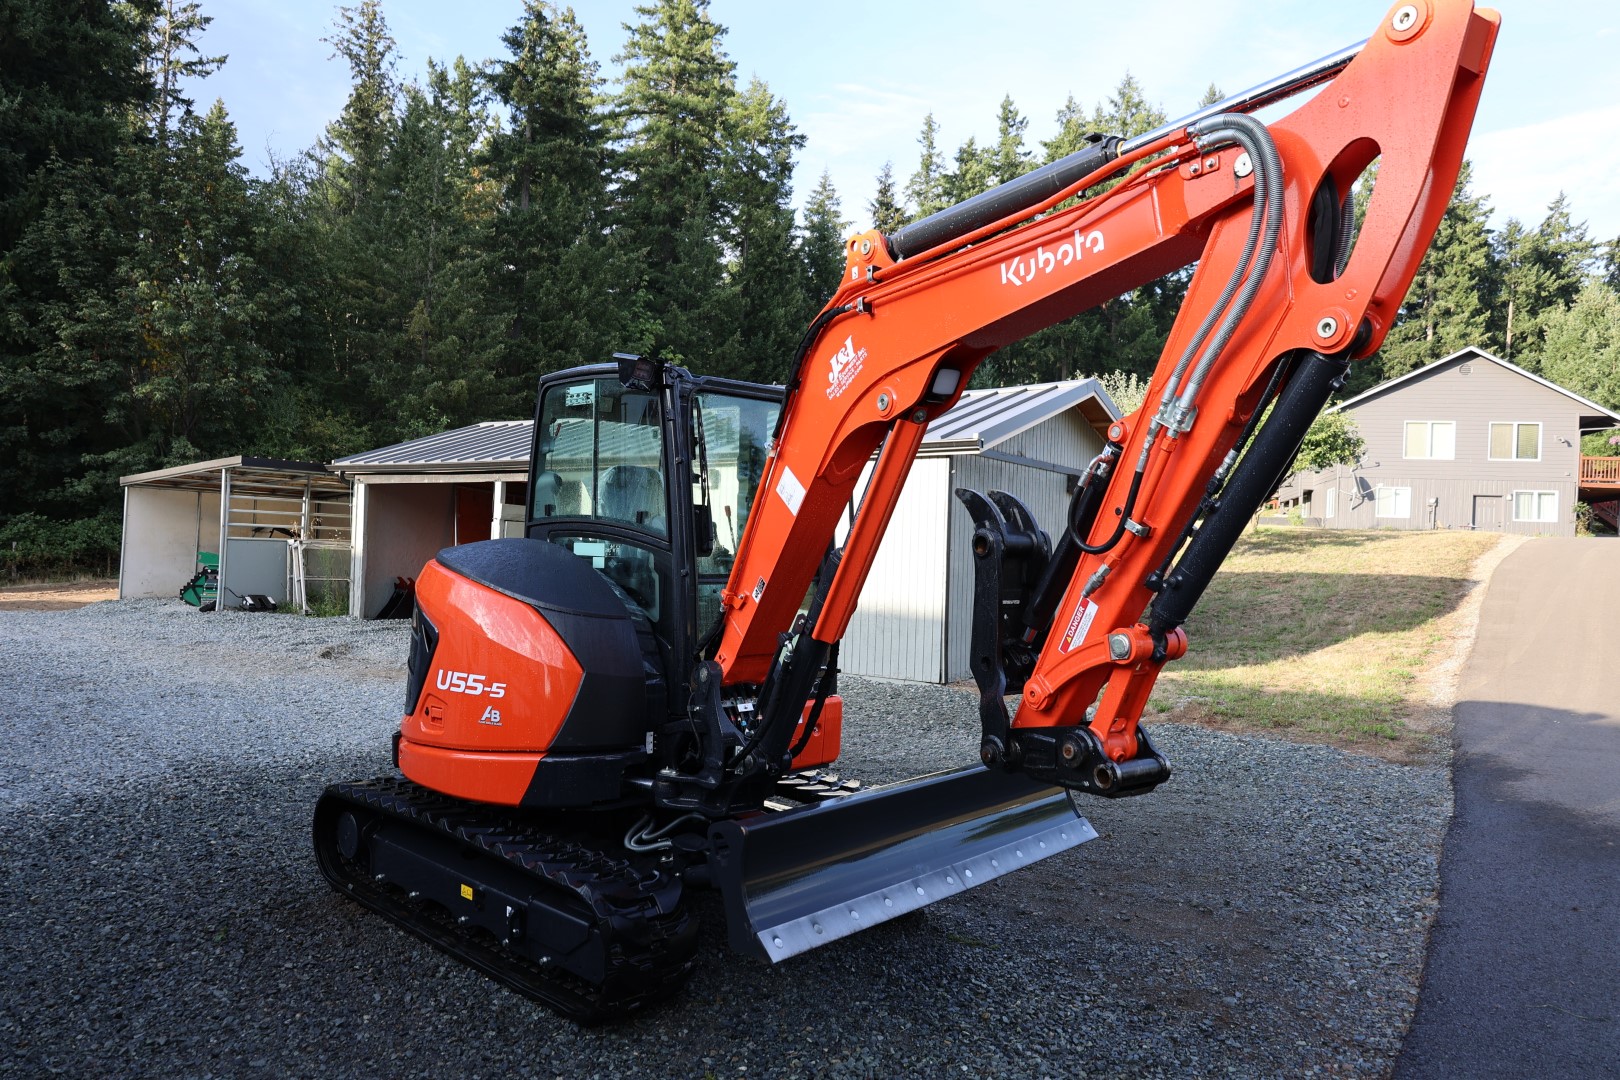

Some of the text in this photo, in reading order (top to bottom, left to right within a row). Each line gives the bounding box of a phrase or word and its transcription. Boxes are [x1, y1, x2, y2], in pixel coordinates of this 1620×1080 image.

[1001, 229, 1105, 286] Kubota
[1067, 606, 1085, 637] DANGER
[436, 669, 507, 698] U55-5
[480, 705, 501, 723] AB
